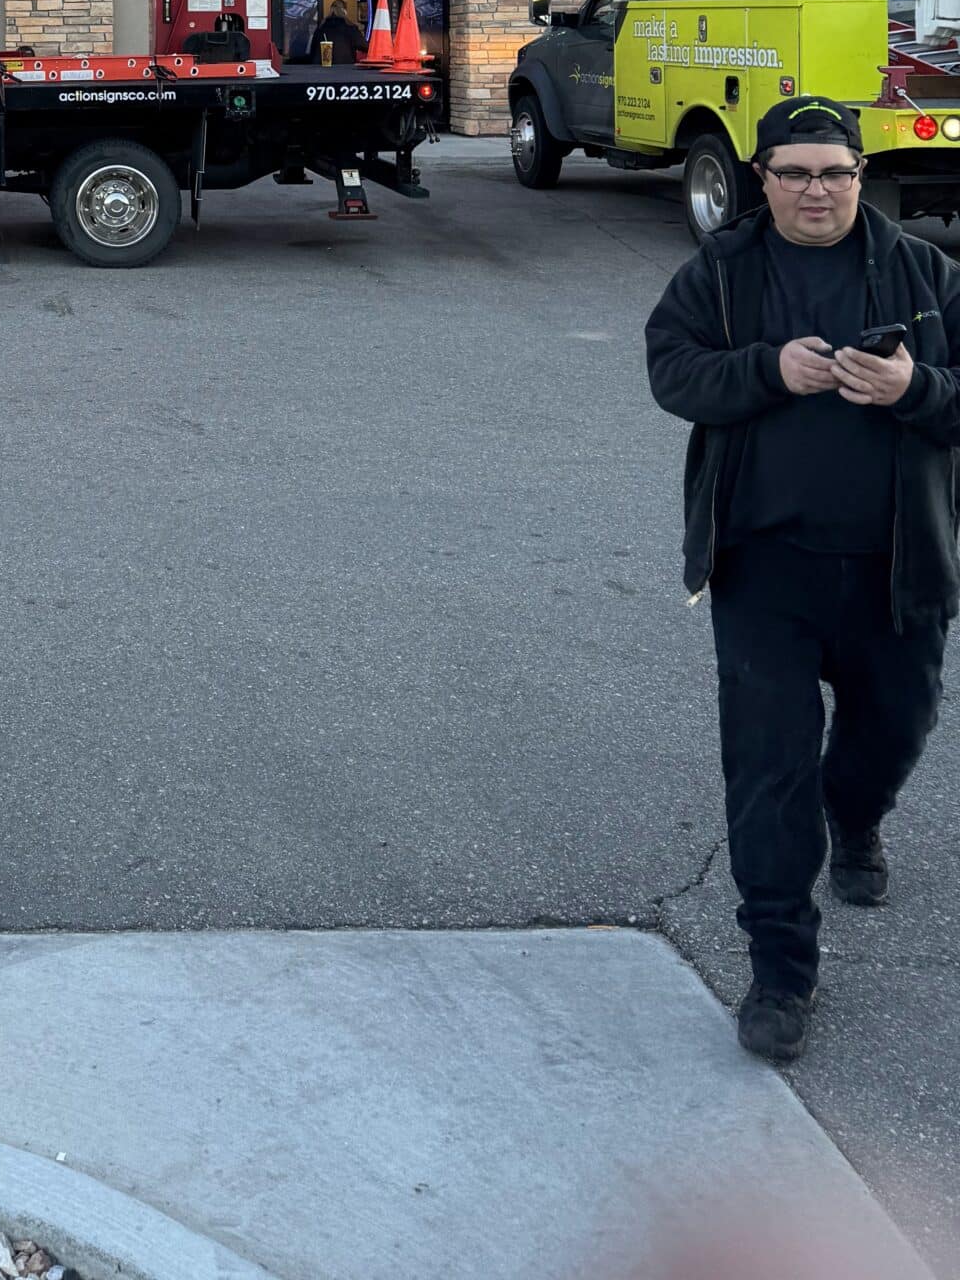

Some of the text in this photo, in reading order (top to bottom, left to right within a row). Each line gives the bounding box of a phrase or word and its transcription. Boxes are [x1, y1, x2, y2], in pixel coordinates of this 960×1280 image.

[633, 15, 678, 38] make a
[647, 39, 784, 69] lasting impression.
[59, 89, 177, 104] actionsignsco.com
[306, 84, 412, 101] 970.223.2124
